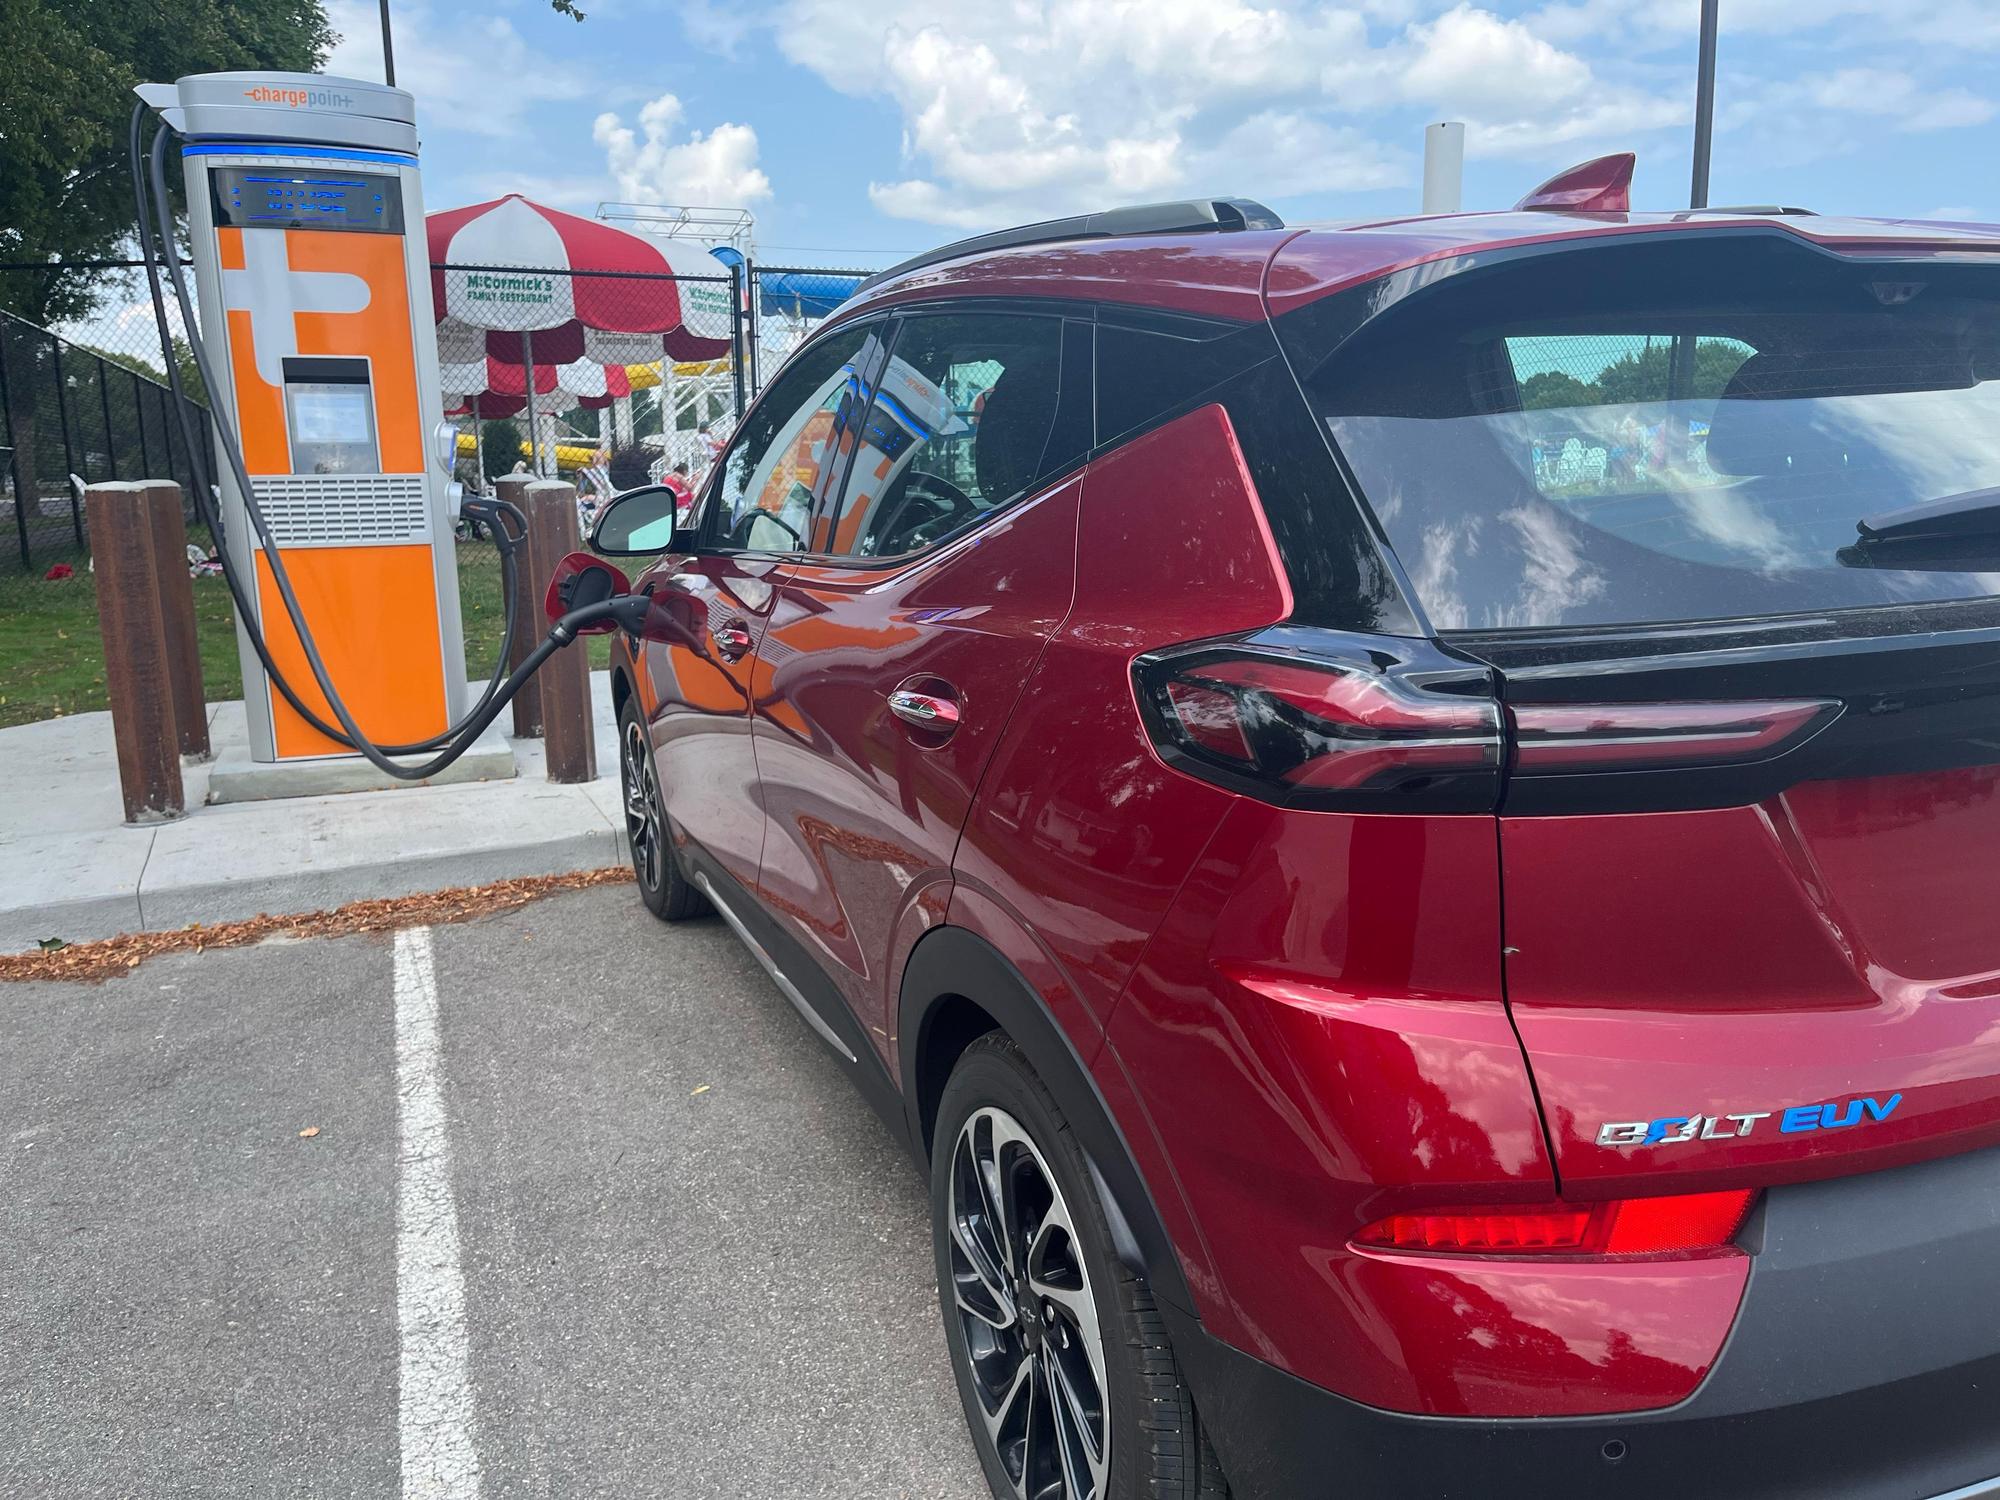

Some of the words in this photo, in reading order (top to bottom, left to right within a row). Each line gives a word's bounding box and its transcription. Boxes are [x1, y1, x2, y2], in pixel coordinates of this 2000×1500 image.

[244, 86, 353, 108] chargepoint
[467, 275, 552, 291] McCormick's
[467, 291, 496, 301] FAMILY
[499, 292, 552, 304] RESTAURANT
[1595, 1112, 1771, 1147] BOLT
[1779, 1093, 1903, 1134] EUV
